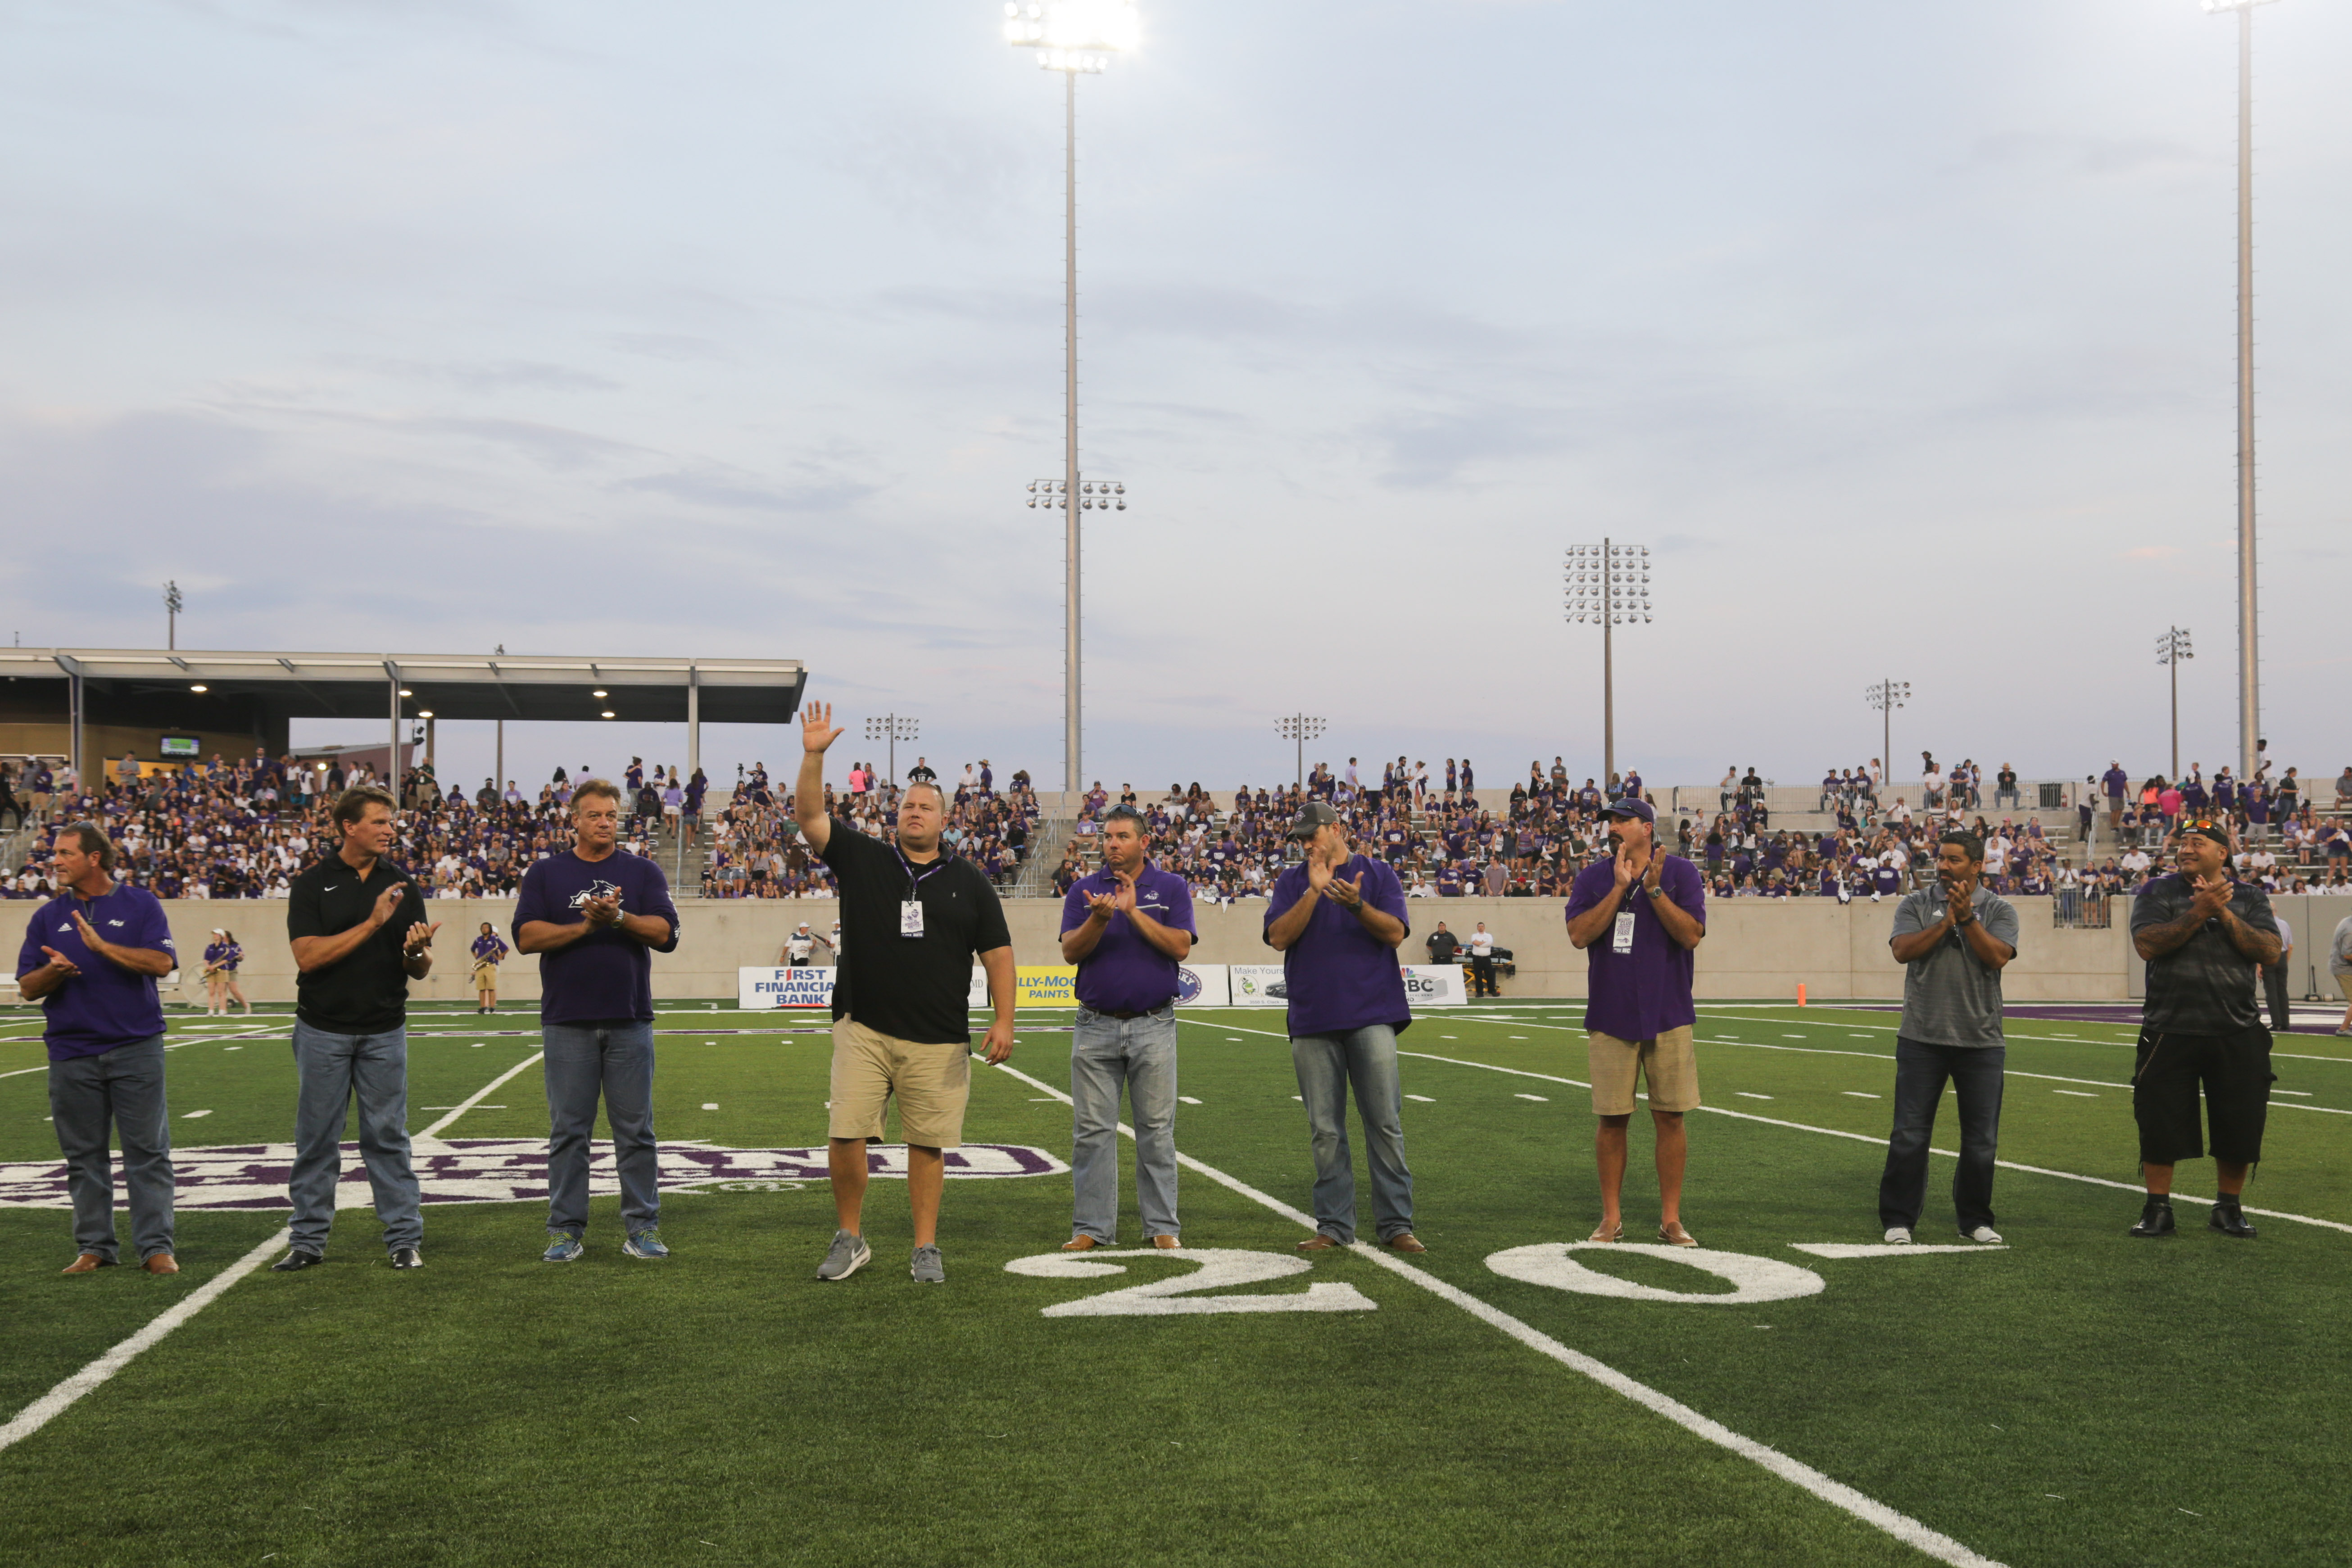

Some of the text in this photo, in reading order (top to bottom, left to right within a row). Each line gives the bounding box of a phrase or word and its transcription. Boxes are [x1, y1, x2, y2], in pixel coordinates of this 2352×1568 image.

[775, 969, 826, 981] FIRST
[1016, 976, 1077, 987] LLY-MOO
[755, 982, 834, 992] FINANCIA
[776, 994, 825, 1004] BANK
[1029, 990, 1070, 998] PAINTS
